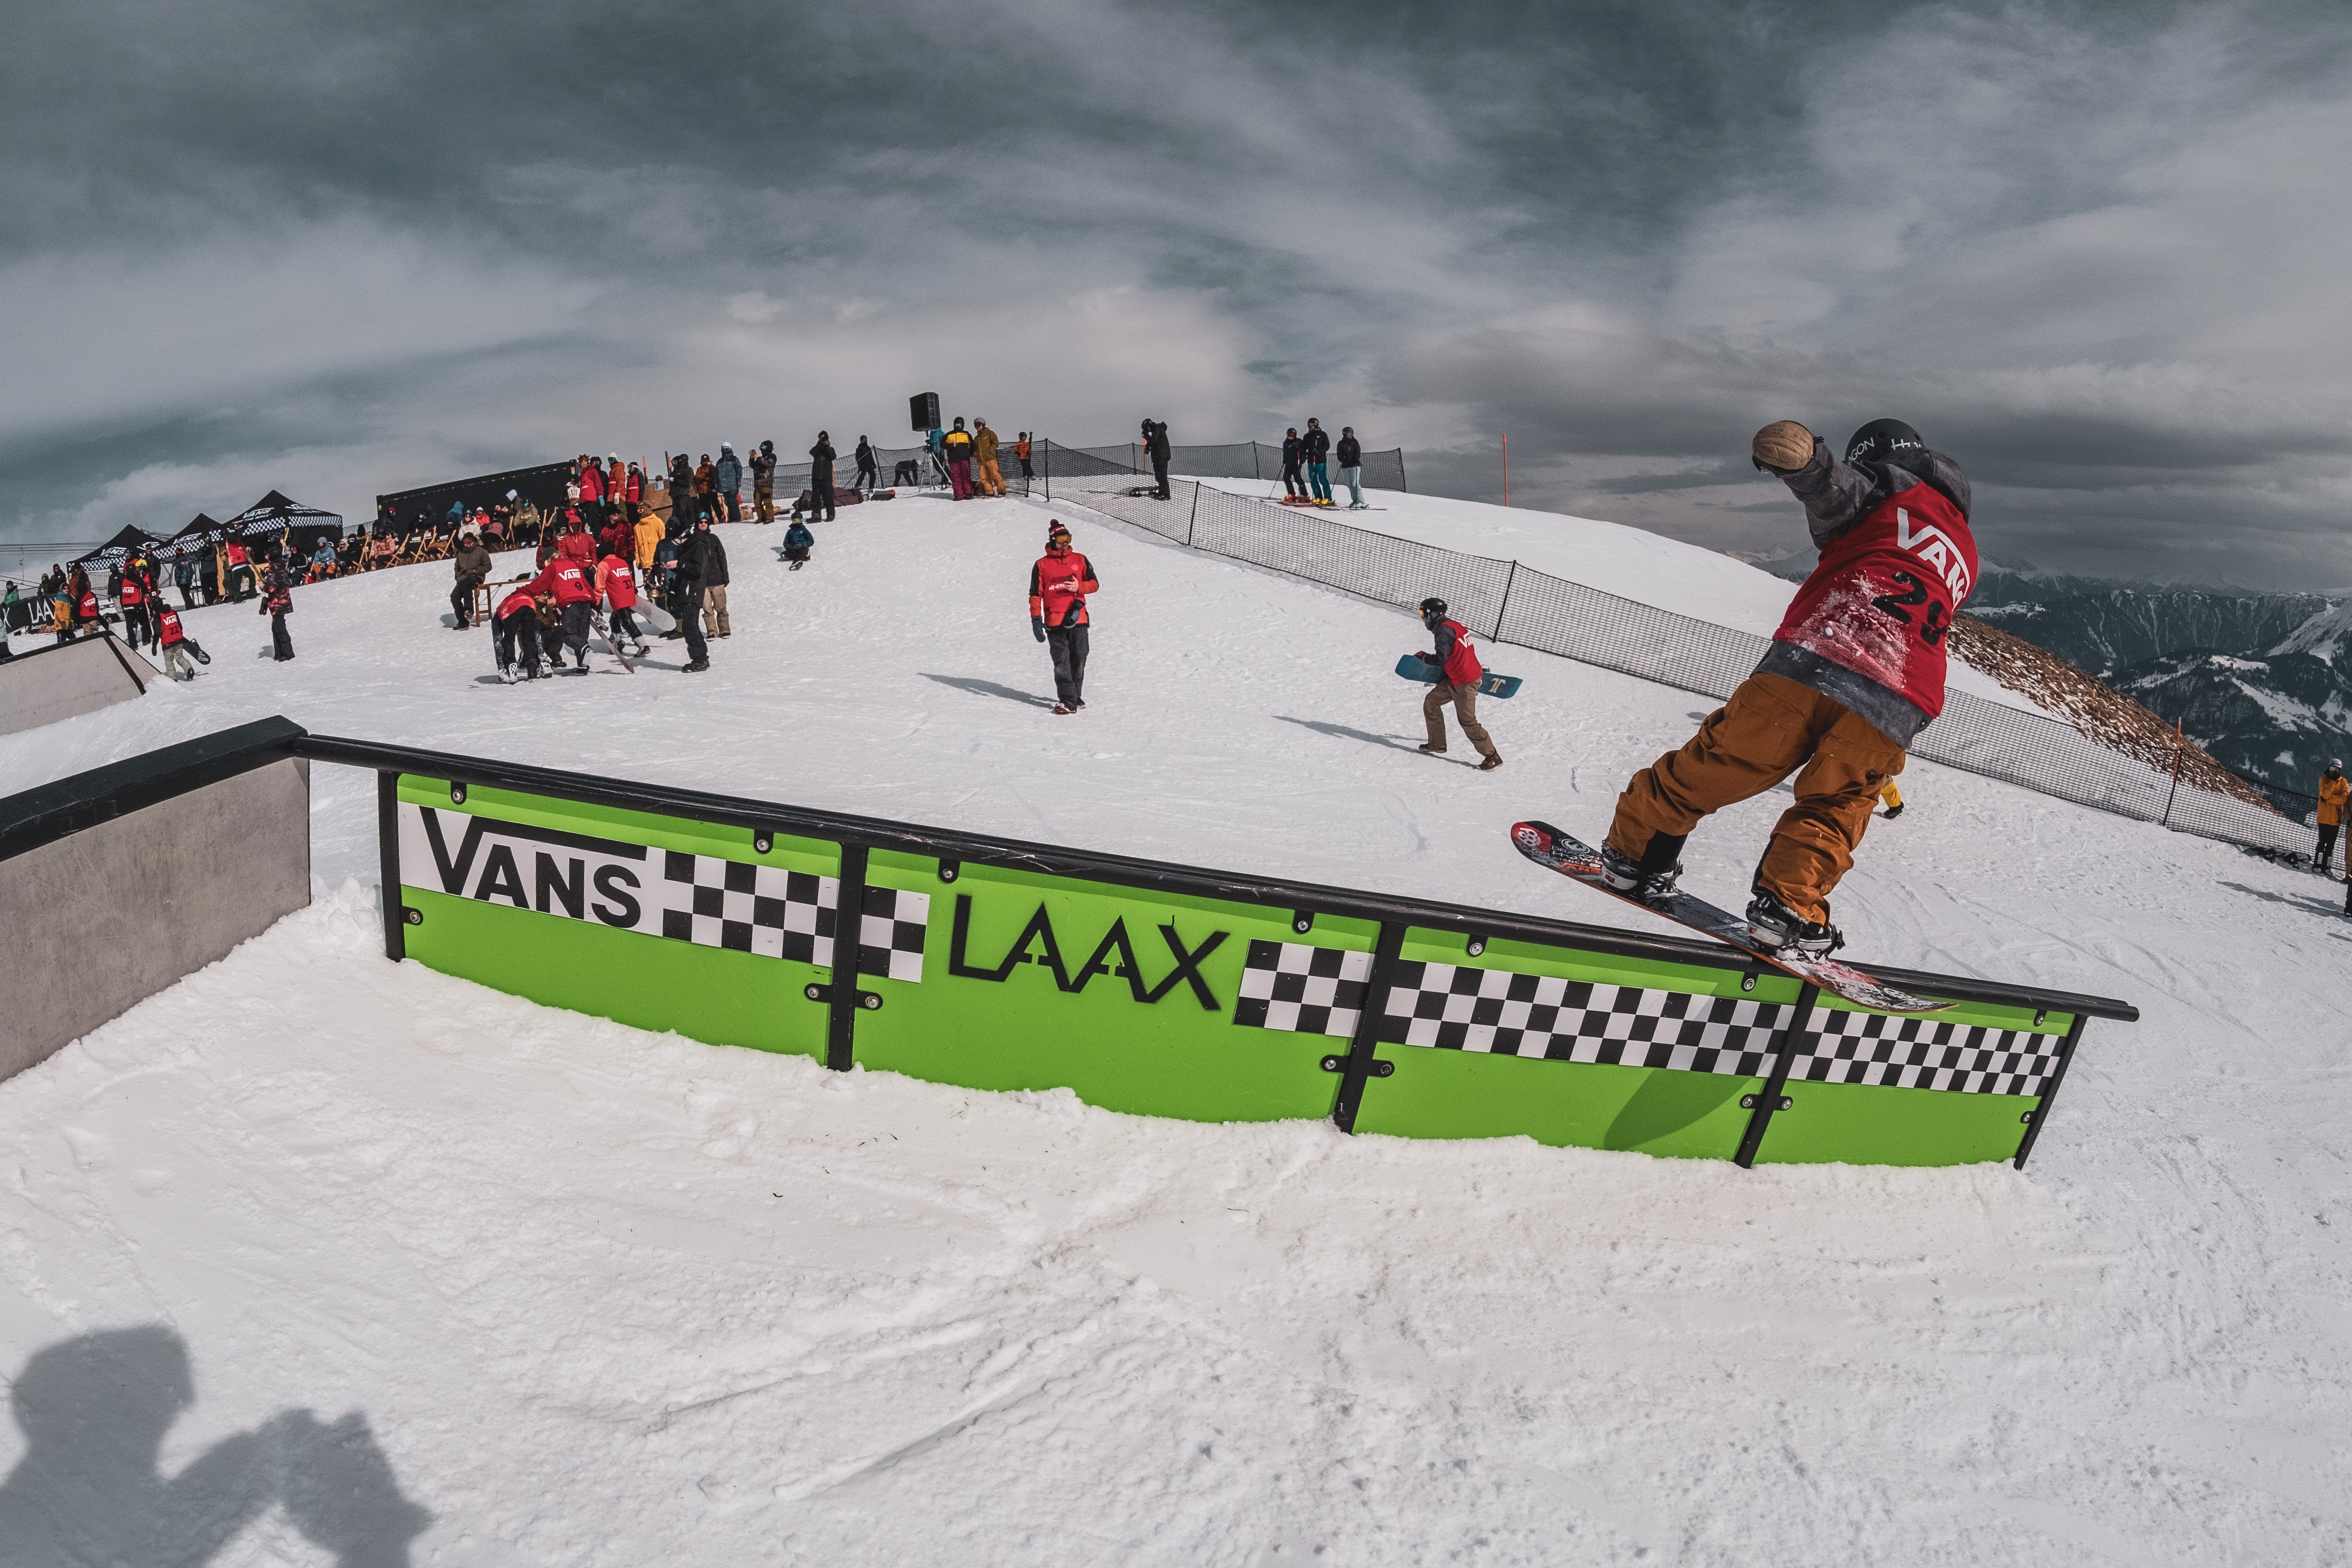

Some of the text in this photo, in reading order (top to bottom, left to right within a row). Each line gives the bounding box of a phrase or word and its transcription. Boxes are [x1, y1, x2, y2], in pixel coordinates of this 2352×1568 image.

[243, 508, 274, 519] VANS
[575, 581, 583, 591] 9
[169, 625, 180, 635] 22
[419, 806, 648, 928] VANS
[1562, 862, 1602, 875] ANS
[949, 894, 1230, 1011] LAAX
